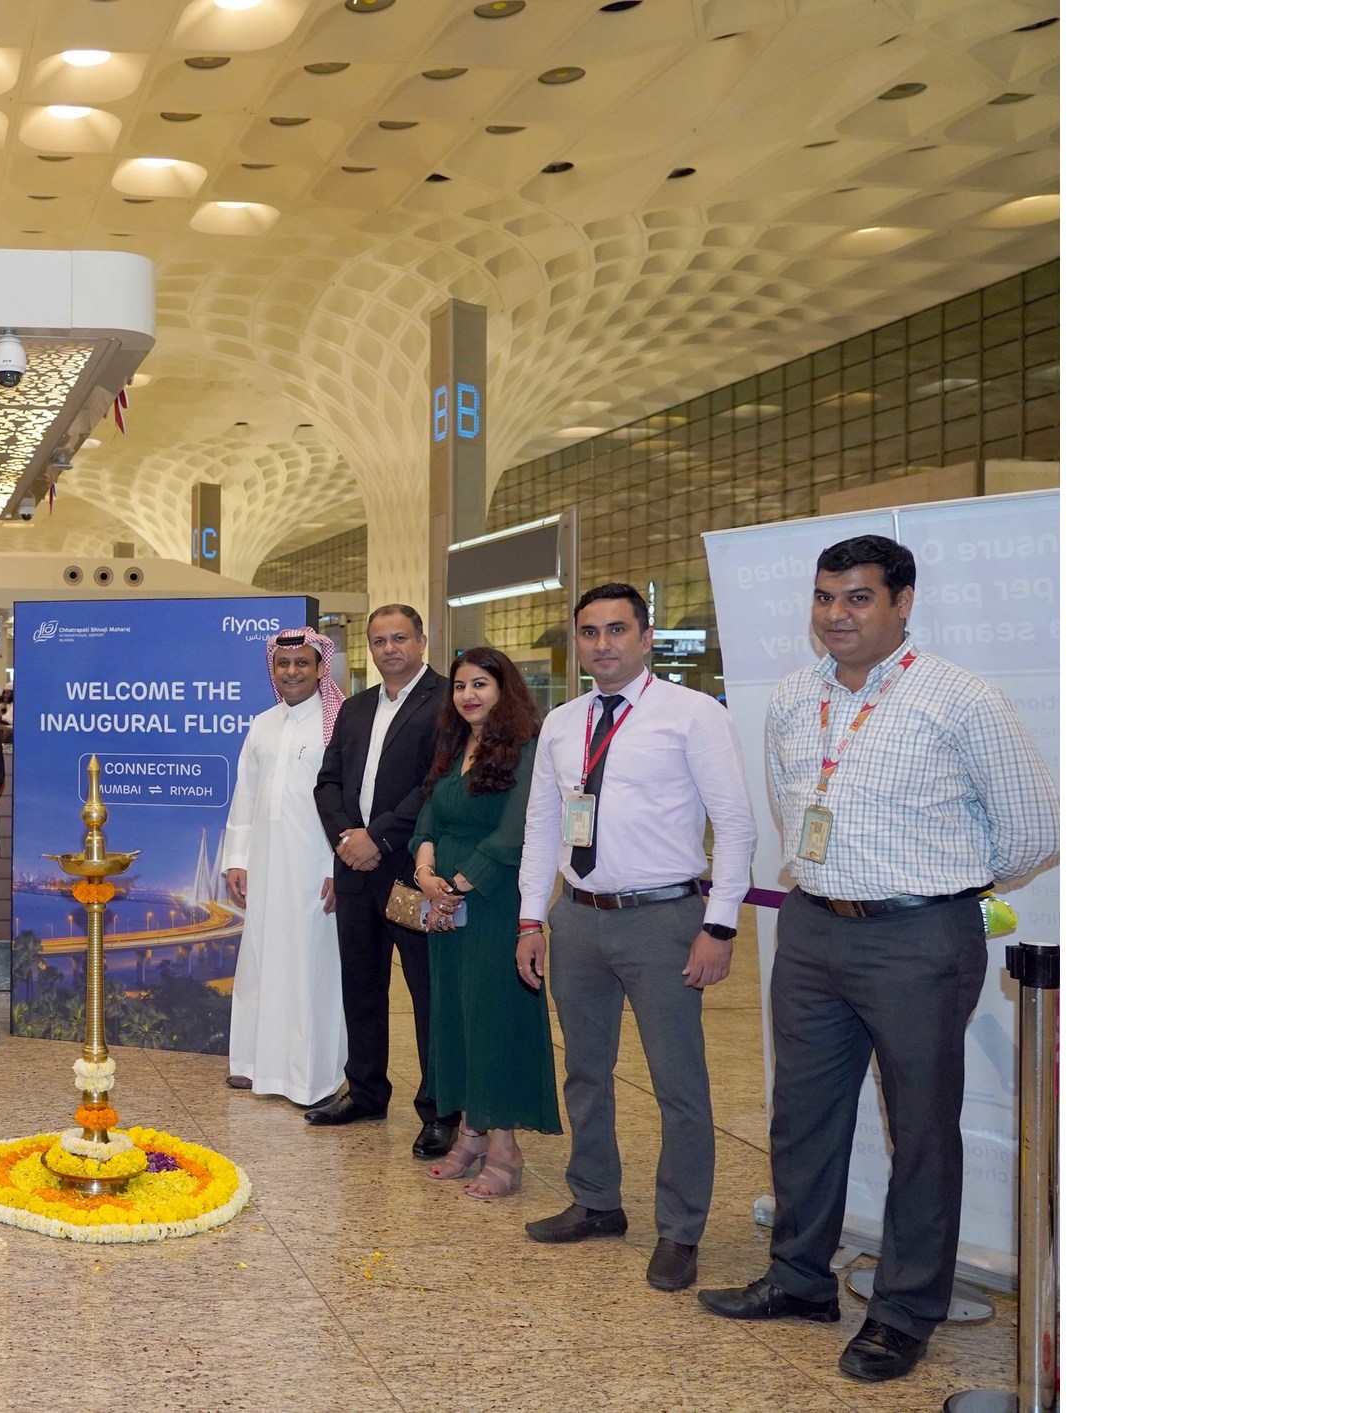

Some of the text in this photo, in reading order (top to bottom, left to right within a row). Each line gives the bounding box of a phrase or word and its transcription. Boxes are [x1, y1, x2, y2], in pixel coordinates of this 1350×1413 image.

[434, 385, 447, 441] B
[457, 382, 479, 438] B
[202, 528, 217, 559] C
[222, 616, 280, 635] flynas
[66, 681, 241, 701] WELCOME THE
[40, 713, 256, 734] INAUGURAL FLIGH
[104, 762, 202, 776] CONNECTING
[170, 785, 212, 797] RIYADH
